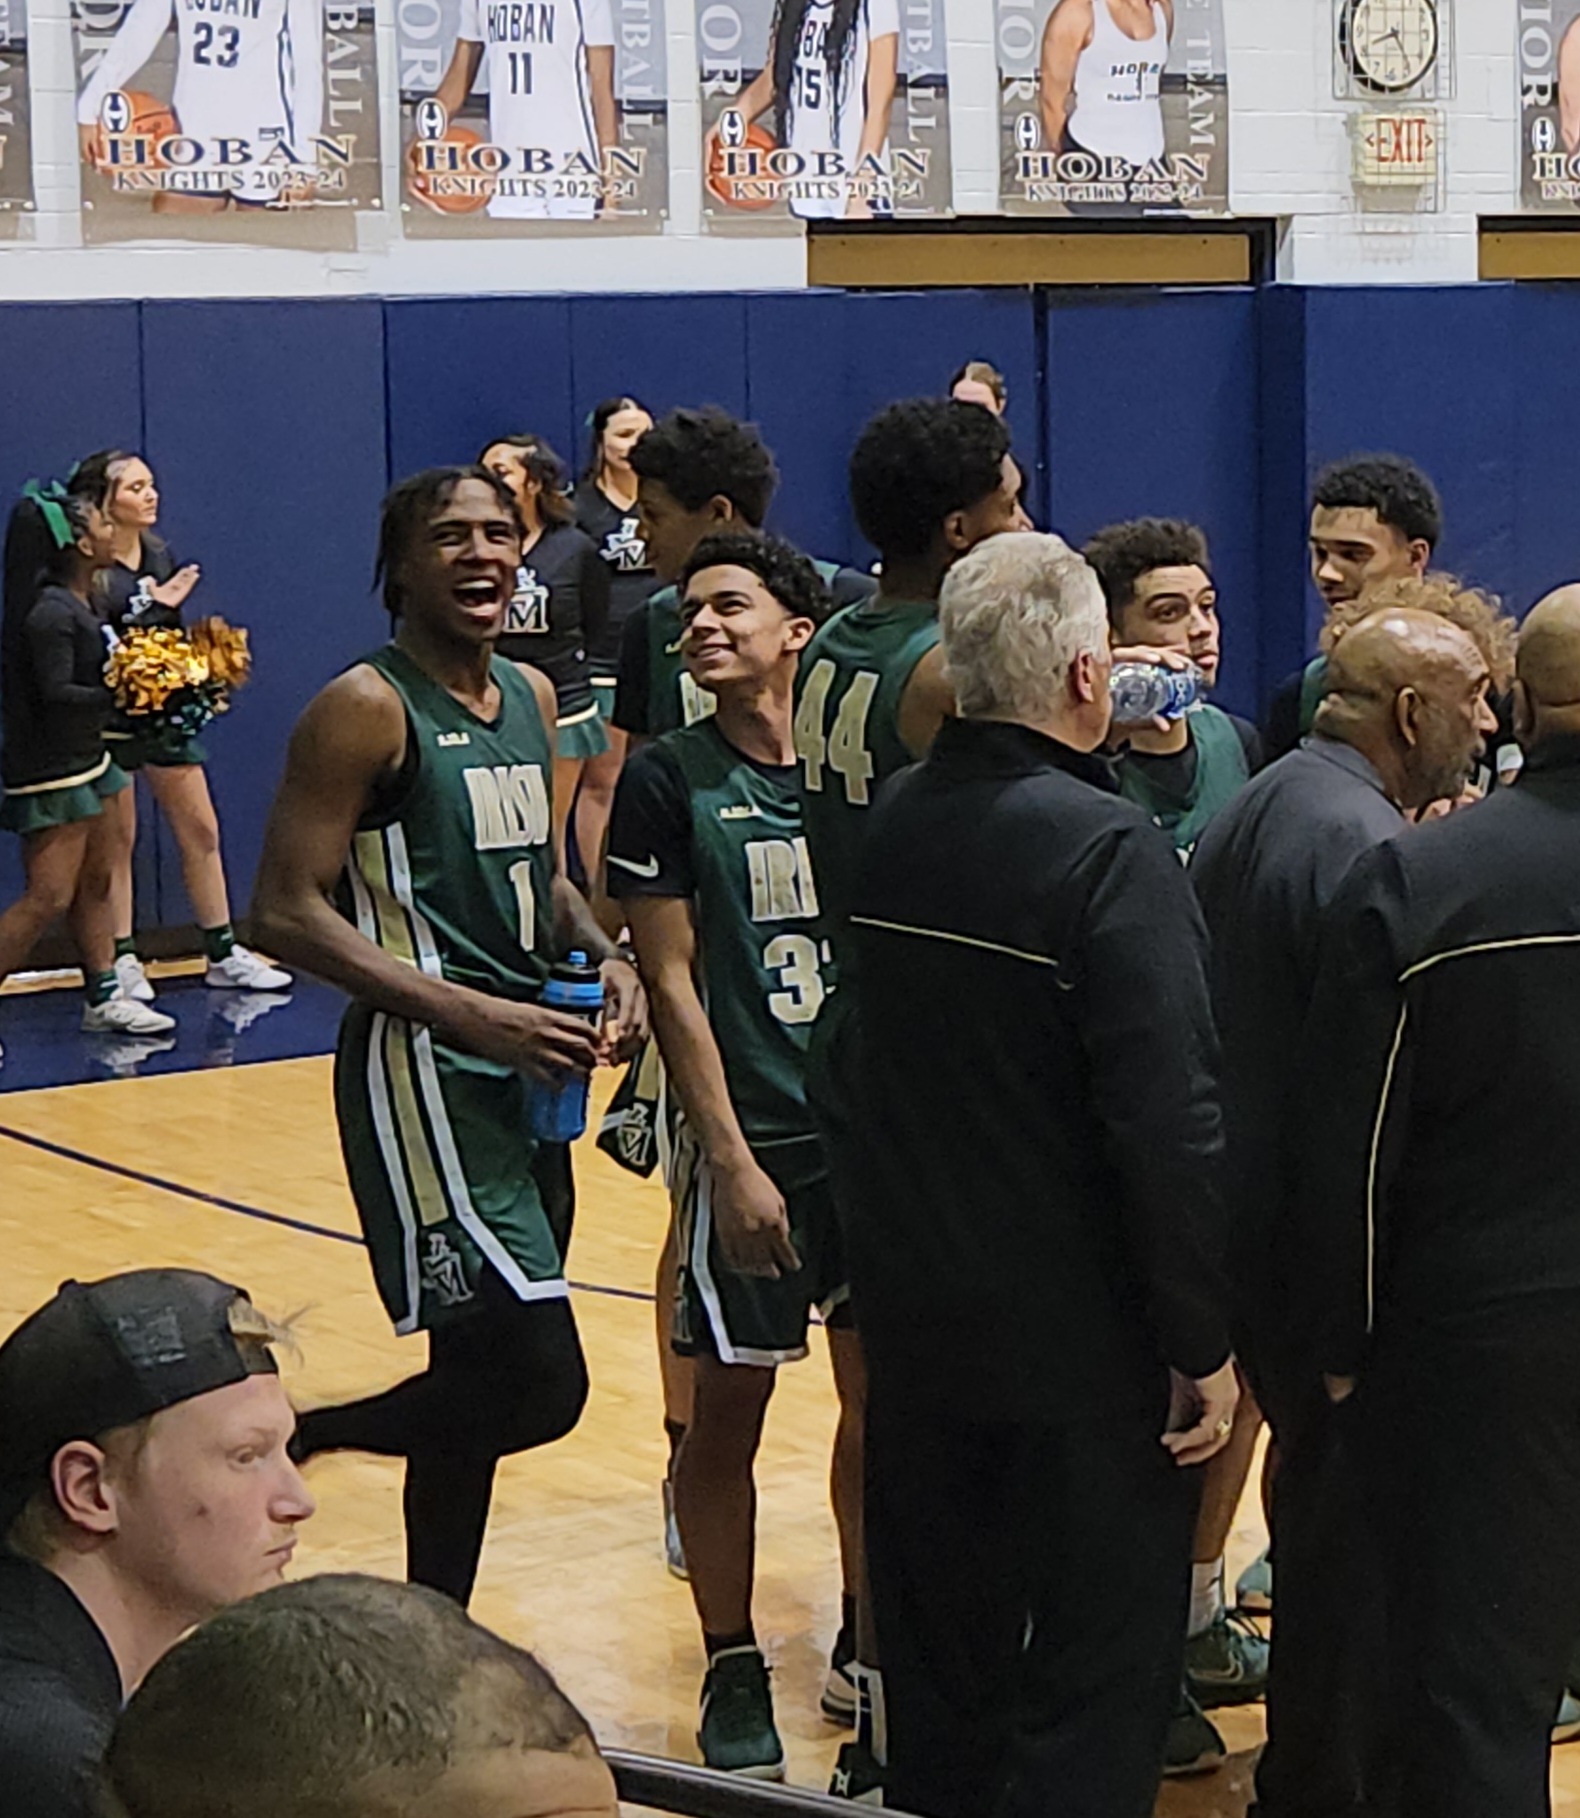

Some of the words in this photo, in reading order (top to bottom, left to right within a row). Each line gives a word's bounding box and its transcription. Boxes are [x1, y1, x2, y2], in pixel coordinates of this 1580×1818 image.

[488, 4, 554, 43] HOBAN
[193, 22, 240, 68] 23
[508, 52, 532, 94] 11
[1186, 30, 1217, 146] TEAM
[97, 134, 357, 167] HOBAN
[417, 141, 647, 177] HOBAN
[1376, 118, 1427, 162] EXIT
[115, 170, 246, 190] KNIGHTS
[252, 169, 347, 190] 2023-24
[719, 148, 931, 178] HOBAN
[1015, 152, 1211, 182] HOBAN
[429, 176, 547, 198] KNIGHTS
[731, 181, 841, 200] KNIGHTS
[795, 658, 880, 805] 44
[509, 860, 535, 951] 1
[763, 934, 836, 1024] 3
